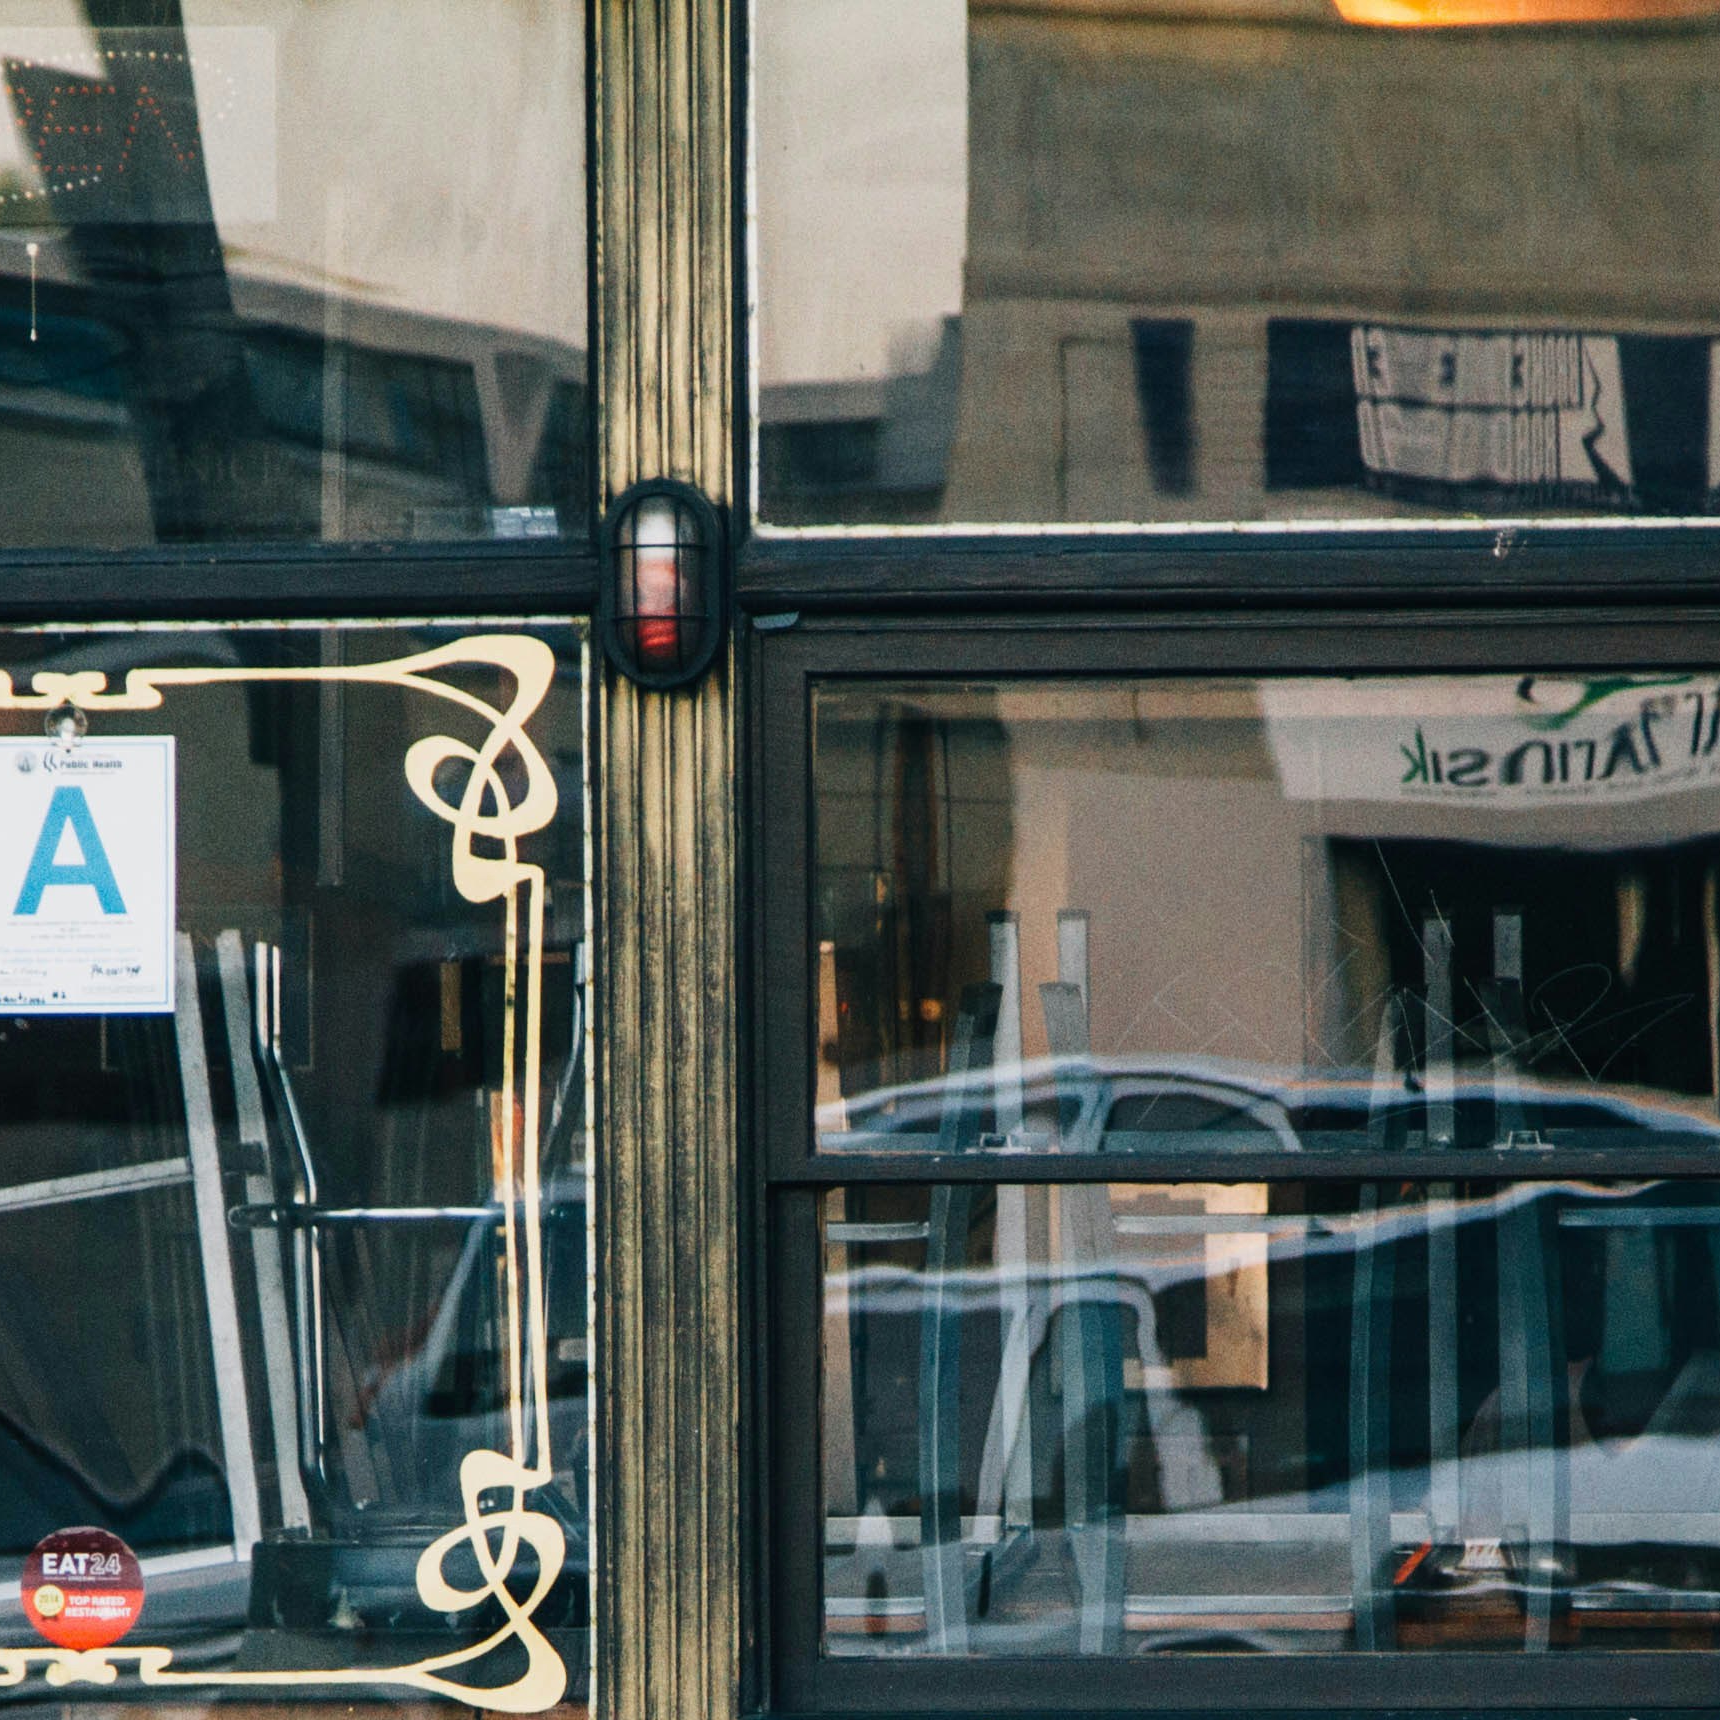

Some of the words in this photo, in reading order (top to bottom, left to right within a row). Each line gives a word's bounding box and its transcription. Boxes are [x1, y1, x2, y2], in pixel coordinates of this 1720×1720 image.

[12, 786, 127, 915] A
[42, 1552, 122, 1575] EAT24
[68, 1596, 90, 1606] TOP
[92, 1596, 127, 1606] RATED
[65, 1607, 132, 1619] RESTAURANT
